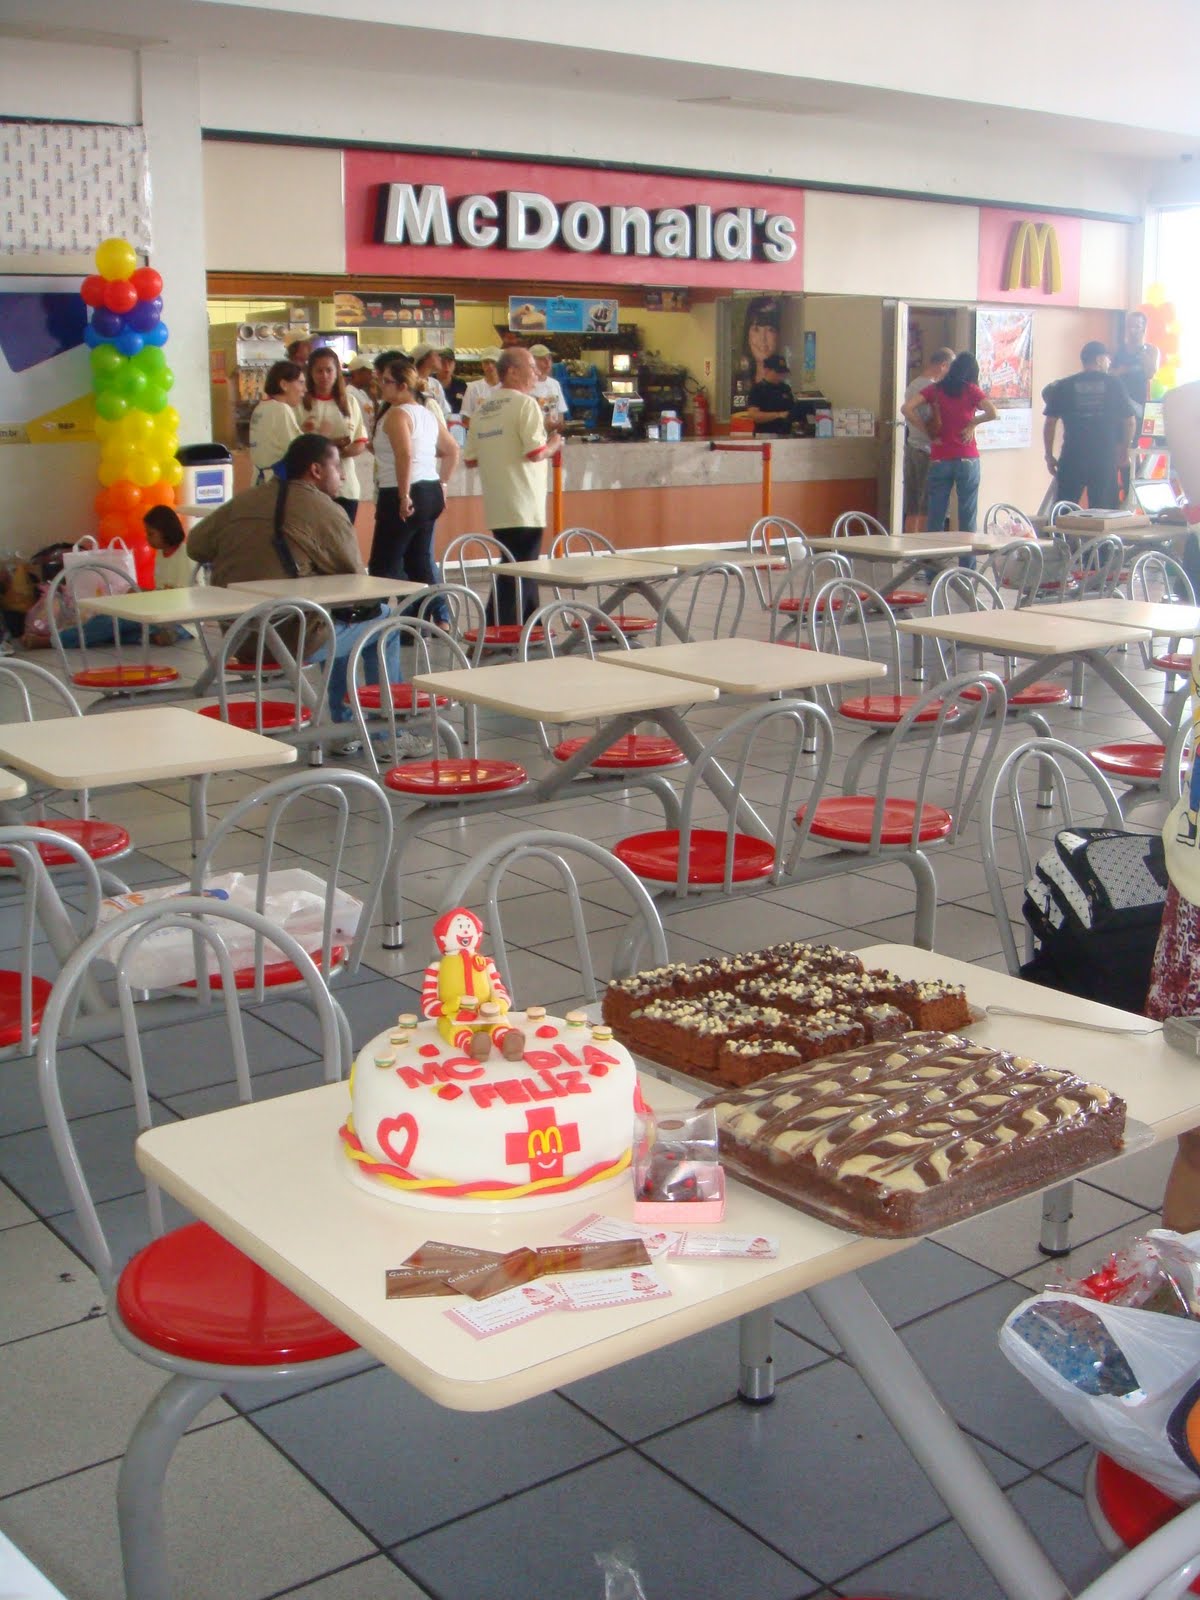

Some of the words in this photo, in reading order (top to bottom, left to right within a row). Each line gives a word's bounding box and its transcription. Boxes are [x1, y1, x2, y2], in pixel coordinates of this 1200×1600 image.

[382, 182, 797, 263] McDonald's
[396, 1057, 485, 1089] MC
[523, 1044, 621, 1070] DIA
[469, 1069, 592, 1108] FELIZ
